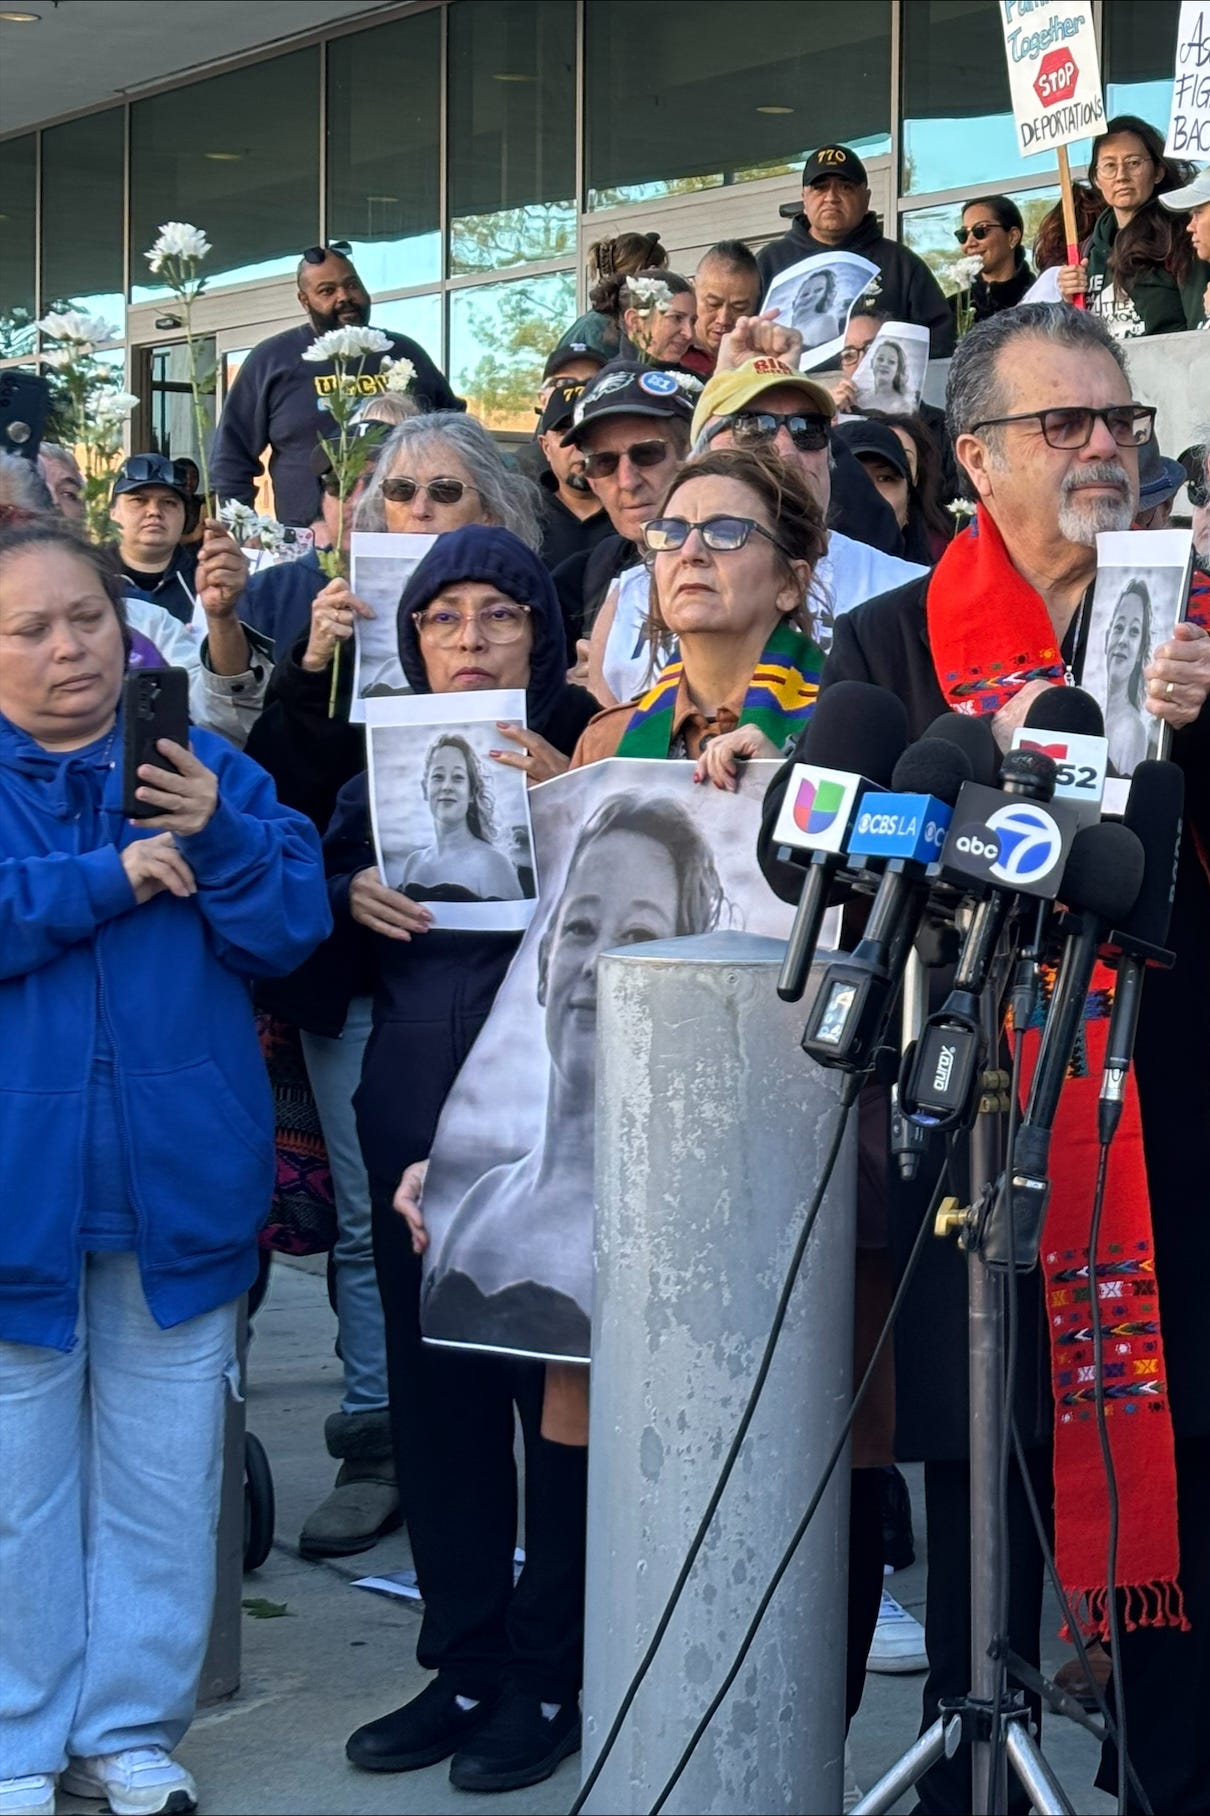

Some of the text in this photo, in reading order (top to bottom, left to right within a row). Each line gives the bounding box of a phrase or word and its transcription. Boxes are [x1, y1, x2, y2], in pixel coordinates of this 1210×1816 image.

[1007, 15, 1086, 63] Together
[1038, 61, 1075, 98] STOP
[1020, 94, 1103, 148] DEPORTATIONS
[1055, 763, 1097, 790] 52
[869, 813, 898, 835] CBS
[897, 816, 917, 836] LA
[956, 836, 999, 859] abc
[990, 806, 1060, 883] 7
[933, 1044, 954, 1092] auray
